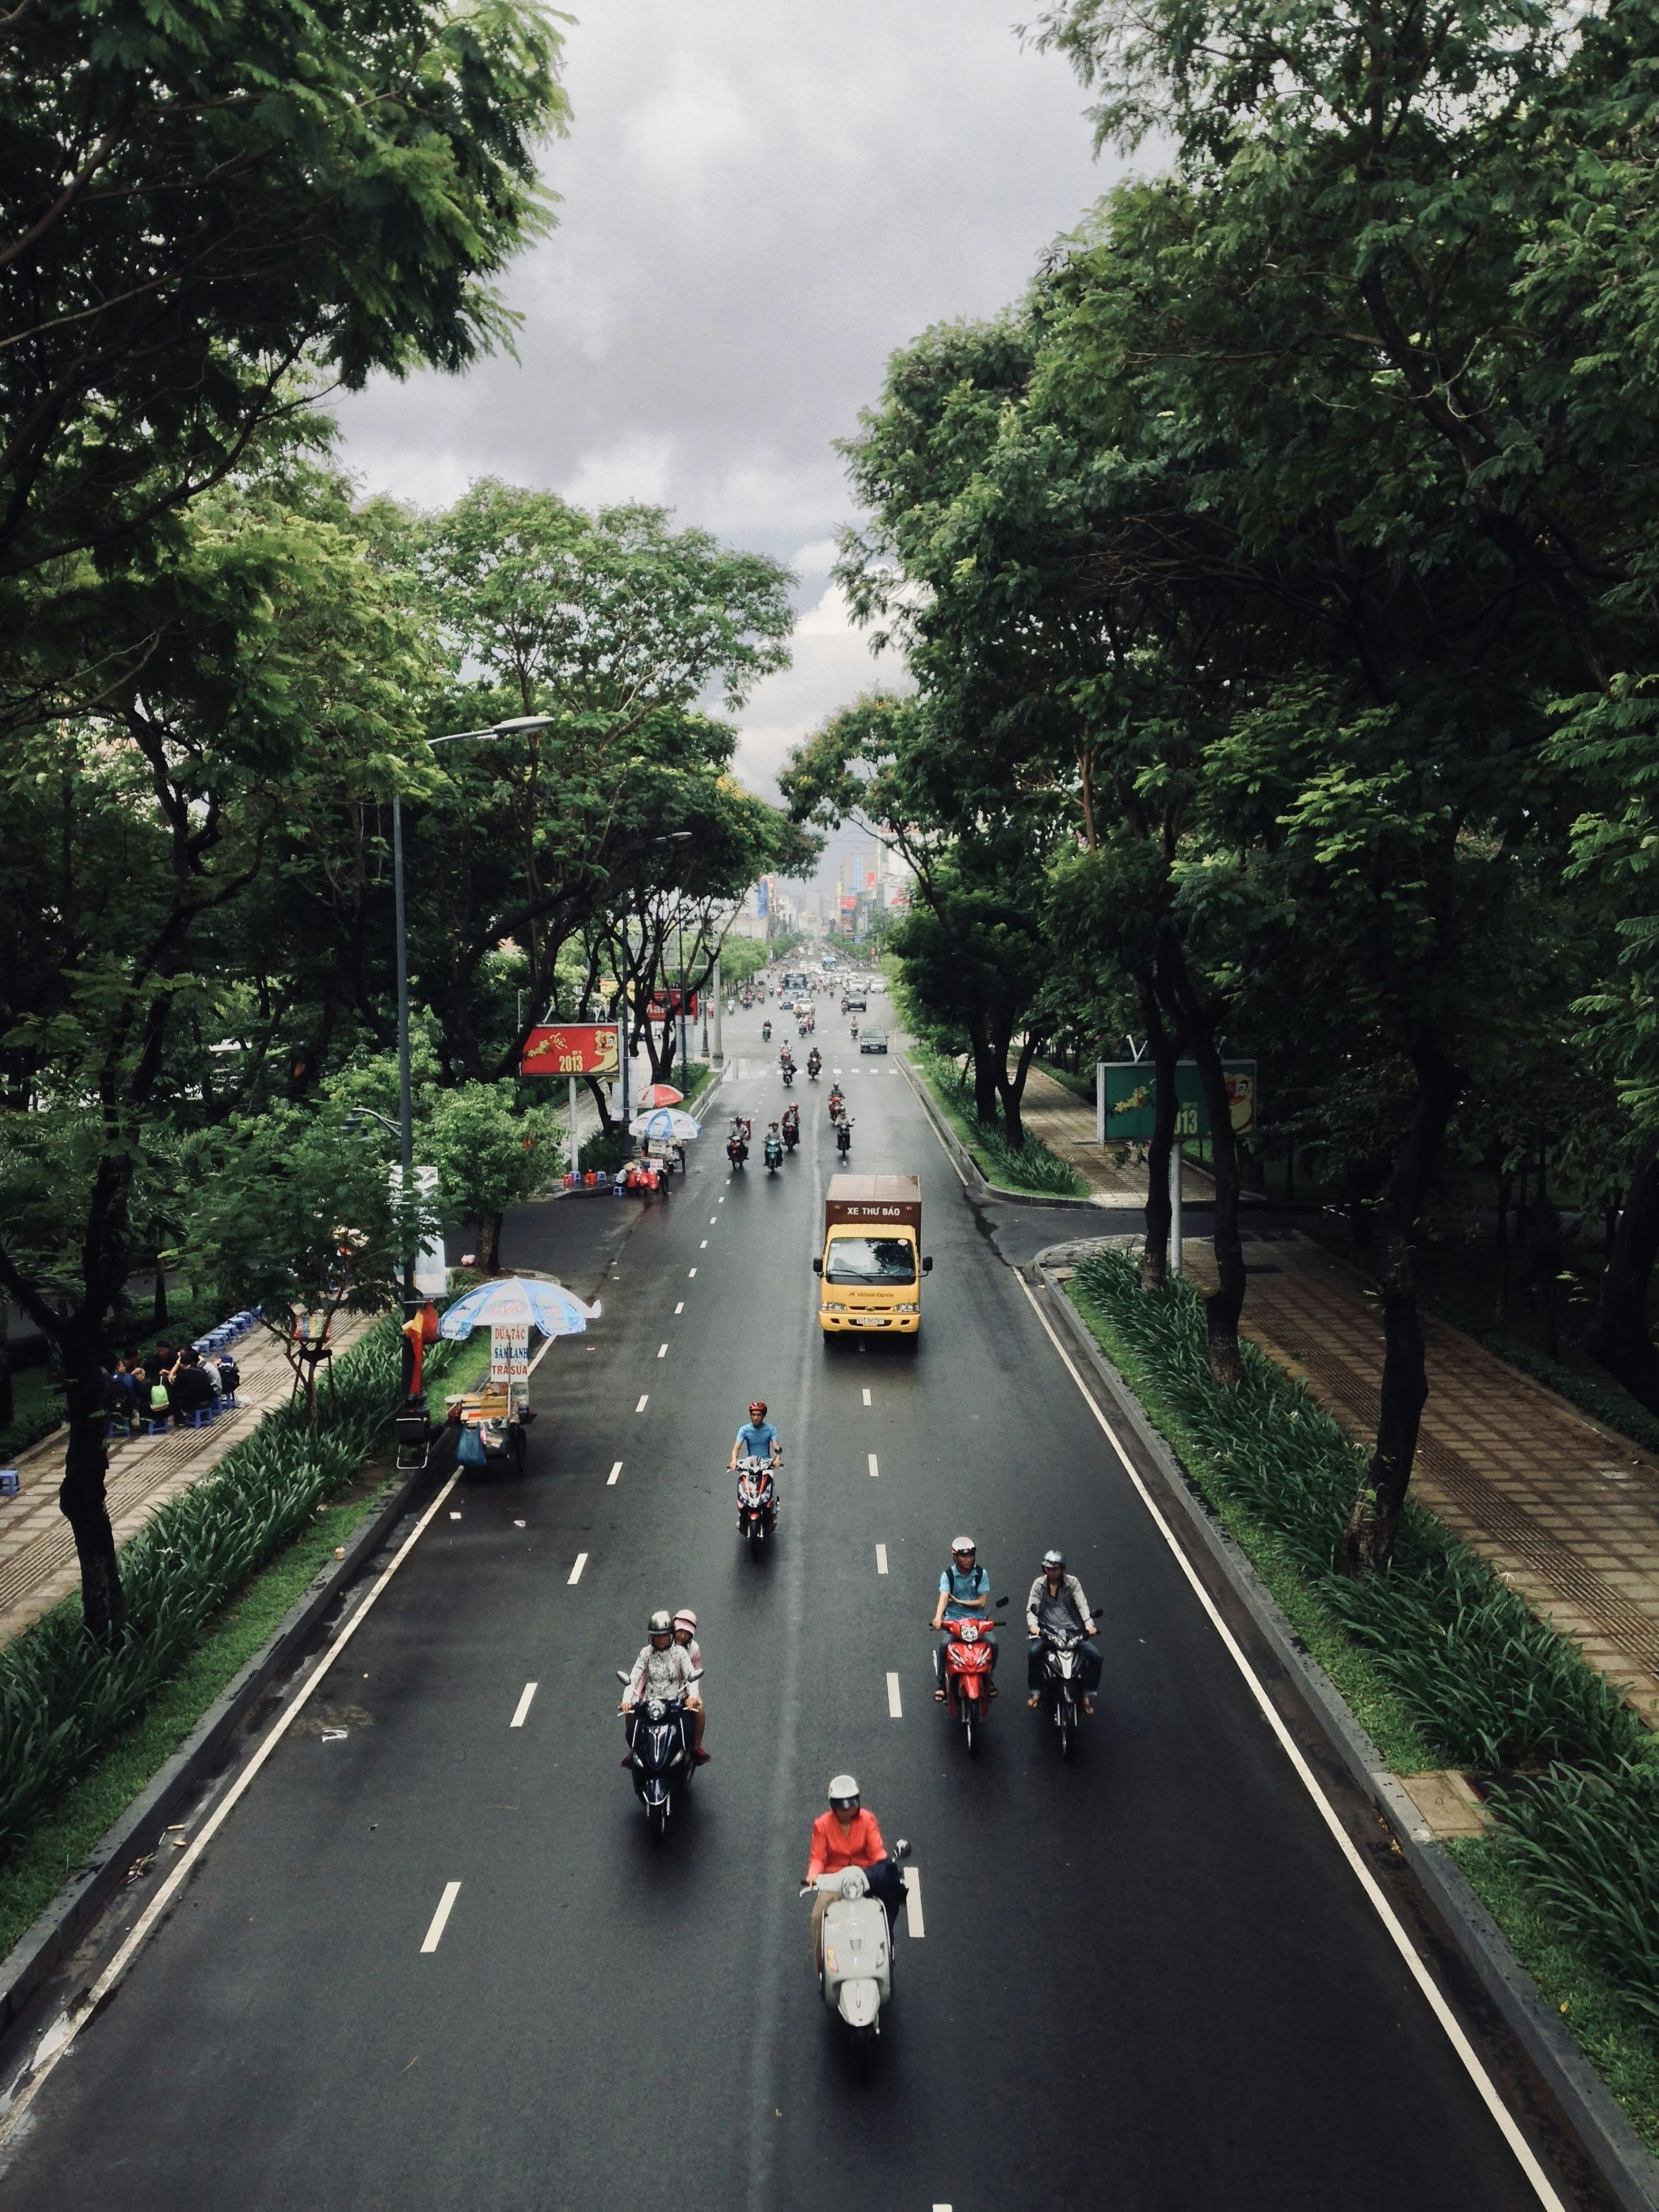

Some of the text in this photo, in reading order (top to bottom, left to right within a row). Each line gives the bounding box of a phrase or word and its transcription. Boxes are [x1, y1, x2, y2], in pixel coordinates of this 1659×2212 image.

[558, 1054, 583, 1072] 2013
[1173, 1109, 1198, 1134] 013
[847, 1206, 901, 1216] XE THƯ BÁO
